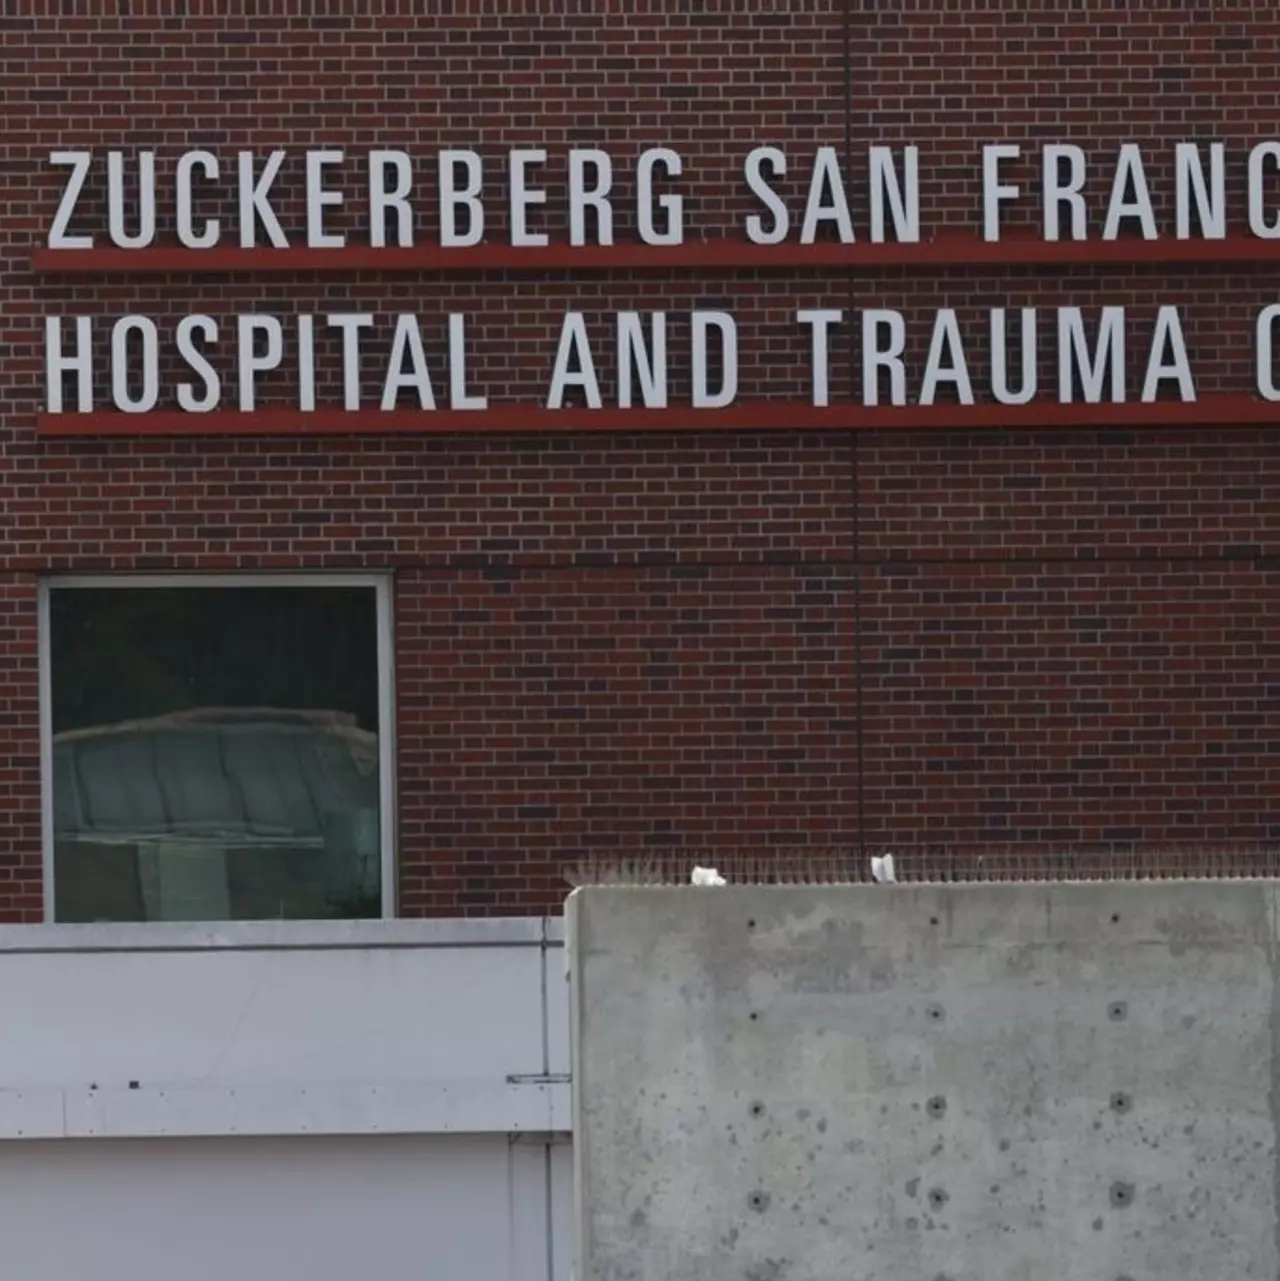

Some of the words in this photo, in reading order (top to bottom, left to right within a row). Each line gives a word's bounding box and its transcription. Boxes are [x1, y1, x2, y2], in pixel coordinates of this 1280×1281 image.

[48, 147, 684, 249] ZUCKERBERG
[744, 145, 921, 244] SAN
[45, 313, 488, 413] HOSPITAL
[547, 311, 739, 409] AND
[797, 305, 1197, 406] TRAUMA
